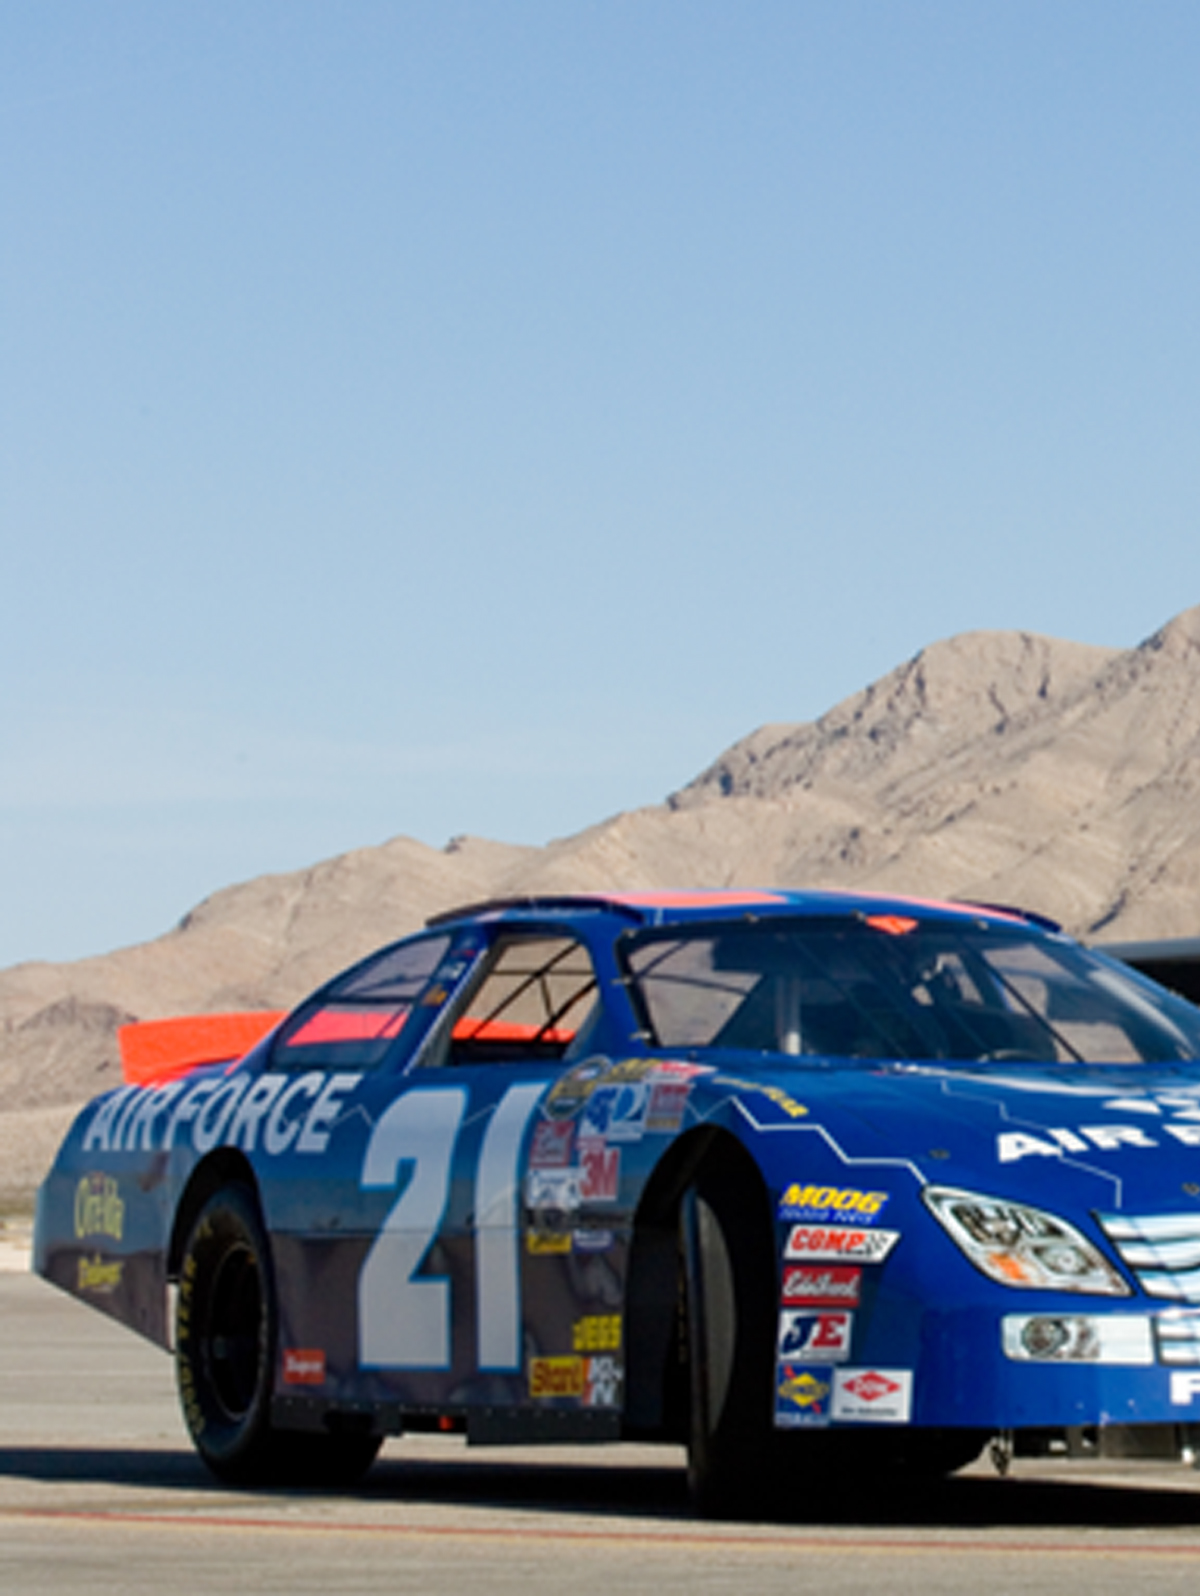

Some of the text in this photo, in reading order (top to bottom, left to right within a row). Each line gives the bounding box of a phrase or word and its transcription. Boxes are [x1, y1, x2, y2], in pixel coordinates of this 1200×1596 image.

[82, 1071, 364, 1155] AIR FORCE
[998, 1124, 1159, 1162] AIR
[779, 1183, 889, 1214] MOOG
[357, 1080, 553, 1373] 21
[790, 1227, 867, 1252] COMP
[781, 1312, 848, 1355] JE
